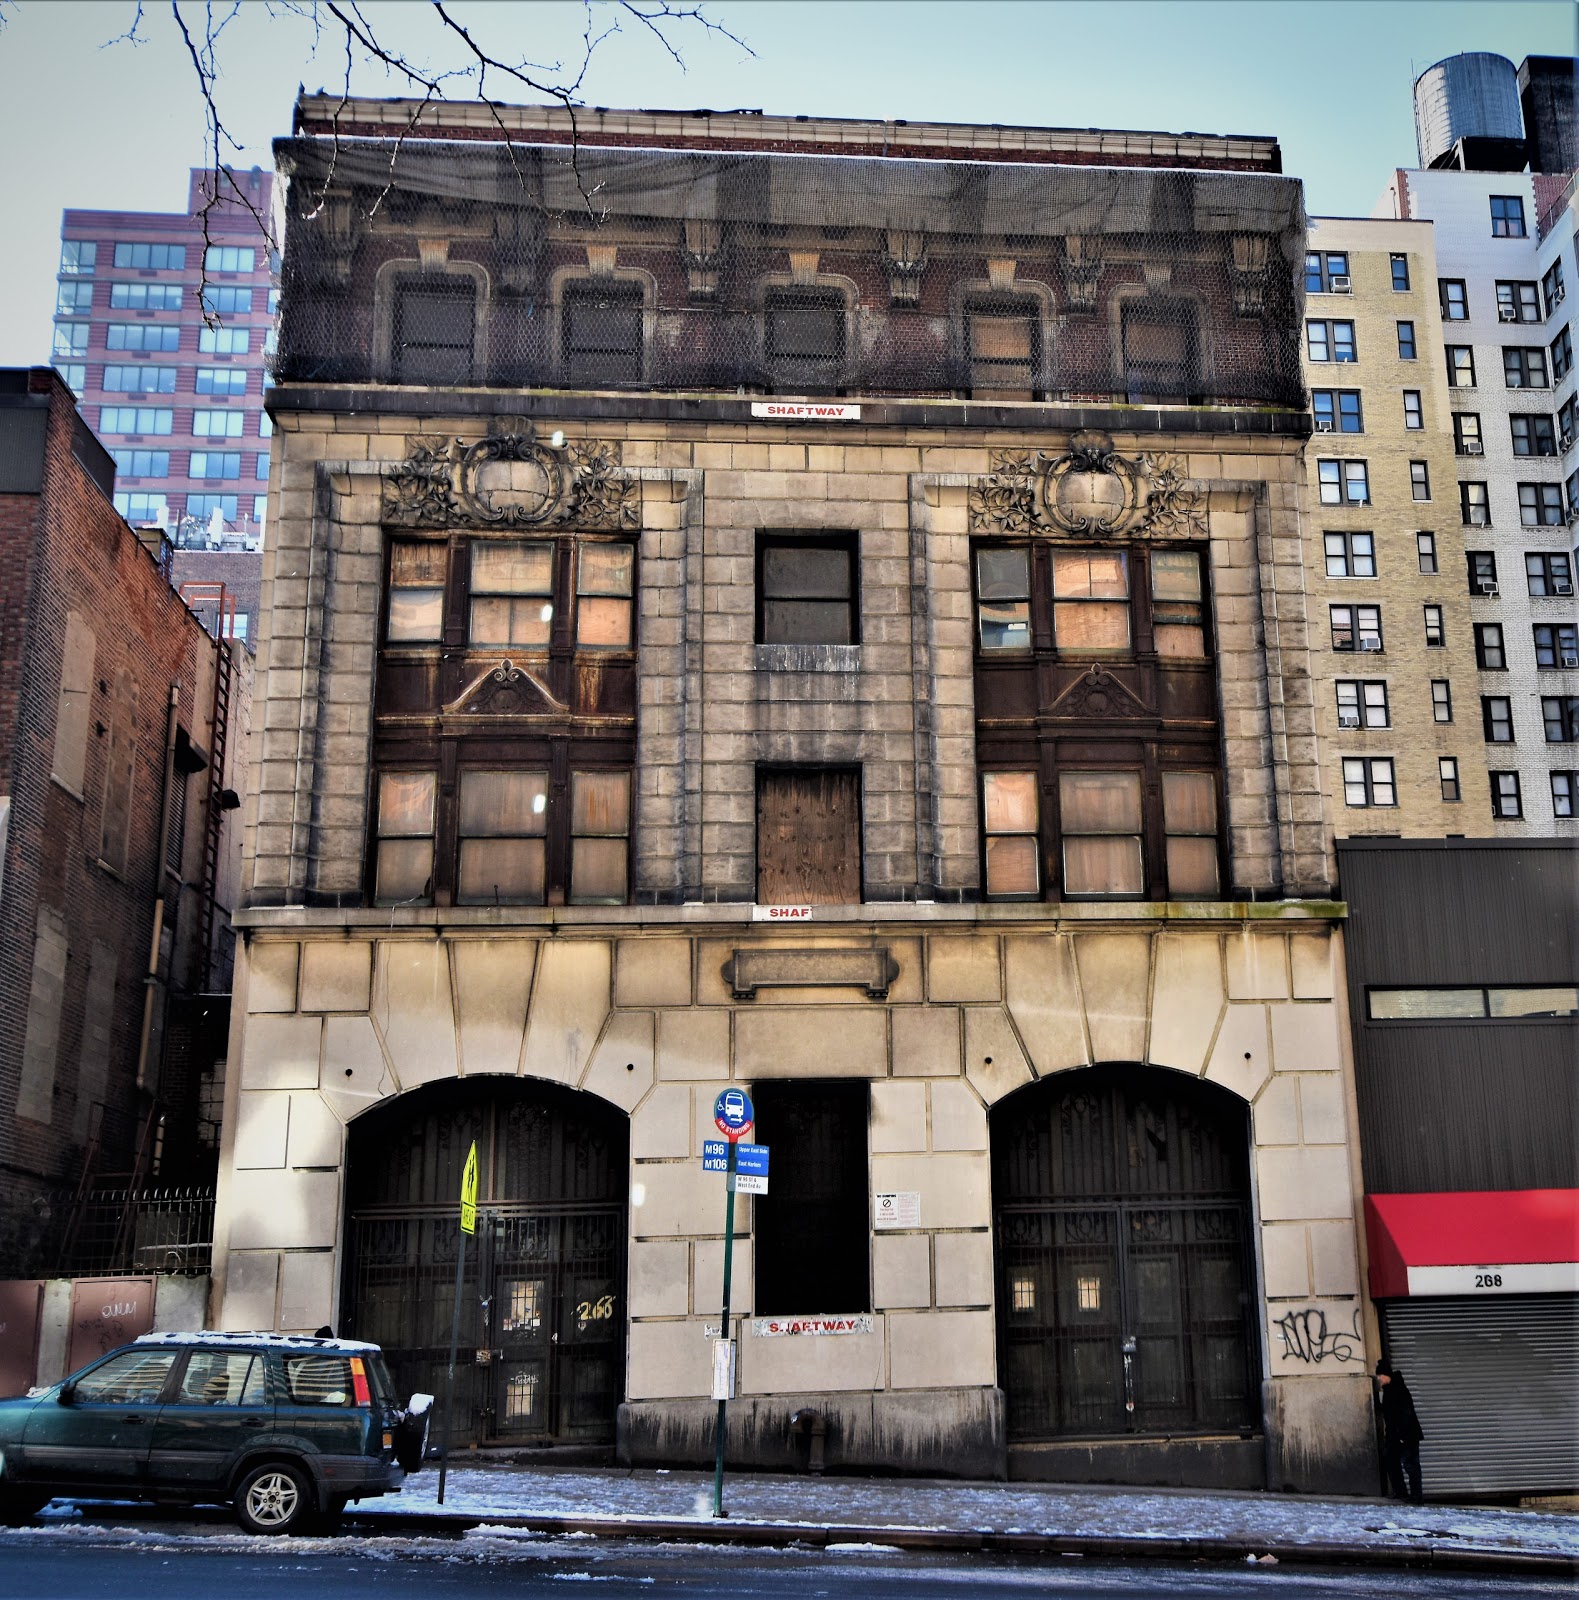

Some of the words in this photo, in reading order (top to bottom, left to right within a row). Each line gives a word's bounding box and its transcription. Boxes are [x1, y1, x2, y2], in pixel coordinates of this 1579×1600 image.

[767, 406, 844, 416] SHAFTWAY
[769, 908, 812, 917] SHAF
[718, 1119, 726, 1129] NO
[725, 1122, 751, 1134] STANDING
[705, 1144, 724, 1155] M96
[704, 1158, 727, 1170] M106
[1475, 1274, 1502, 1288] 268
